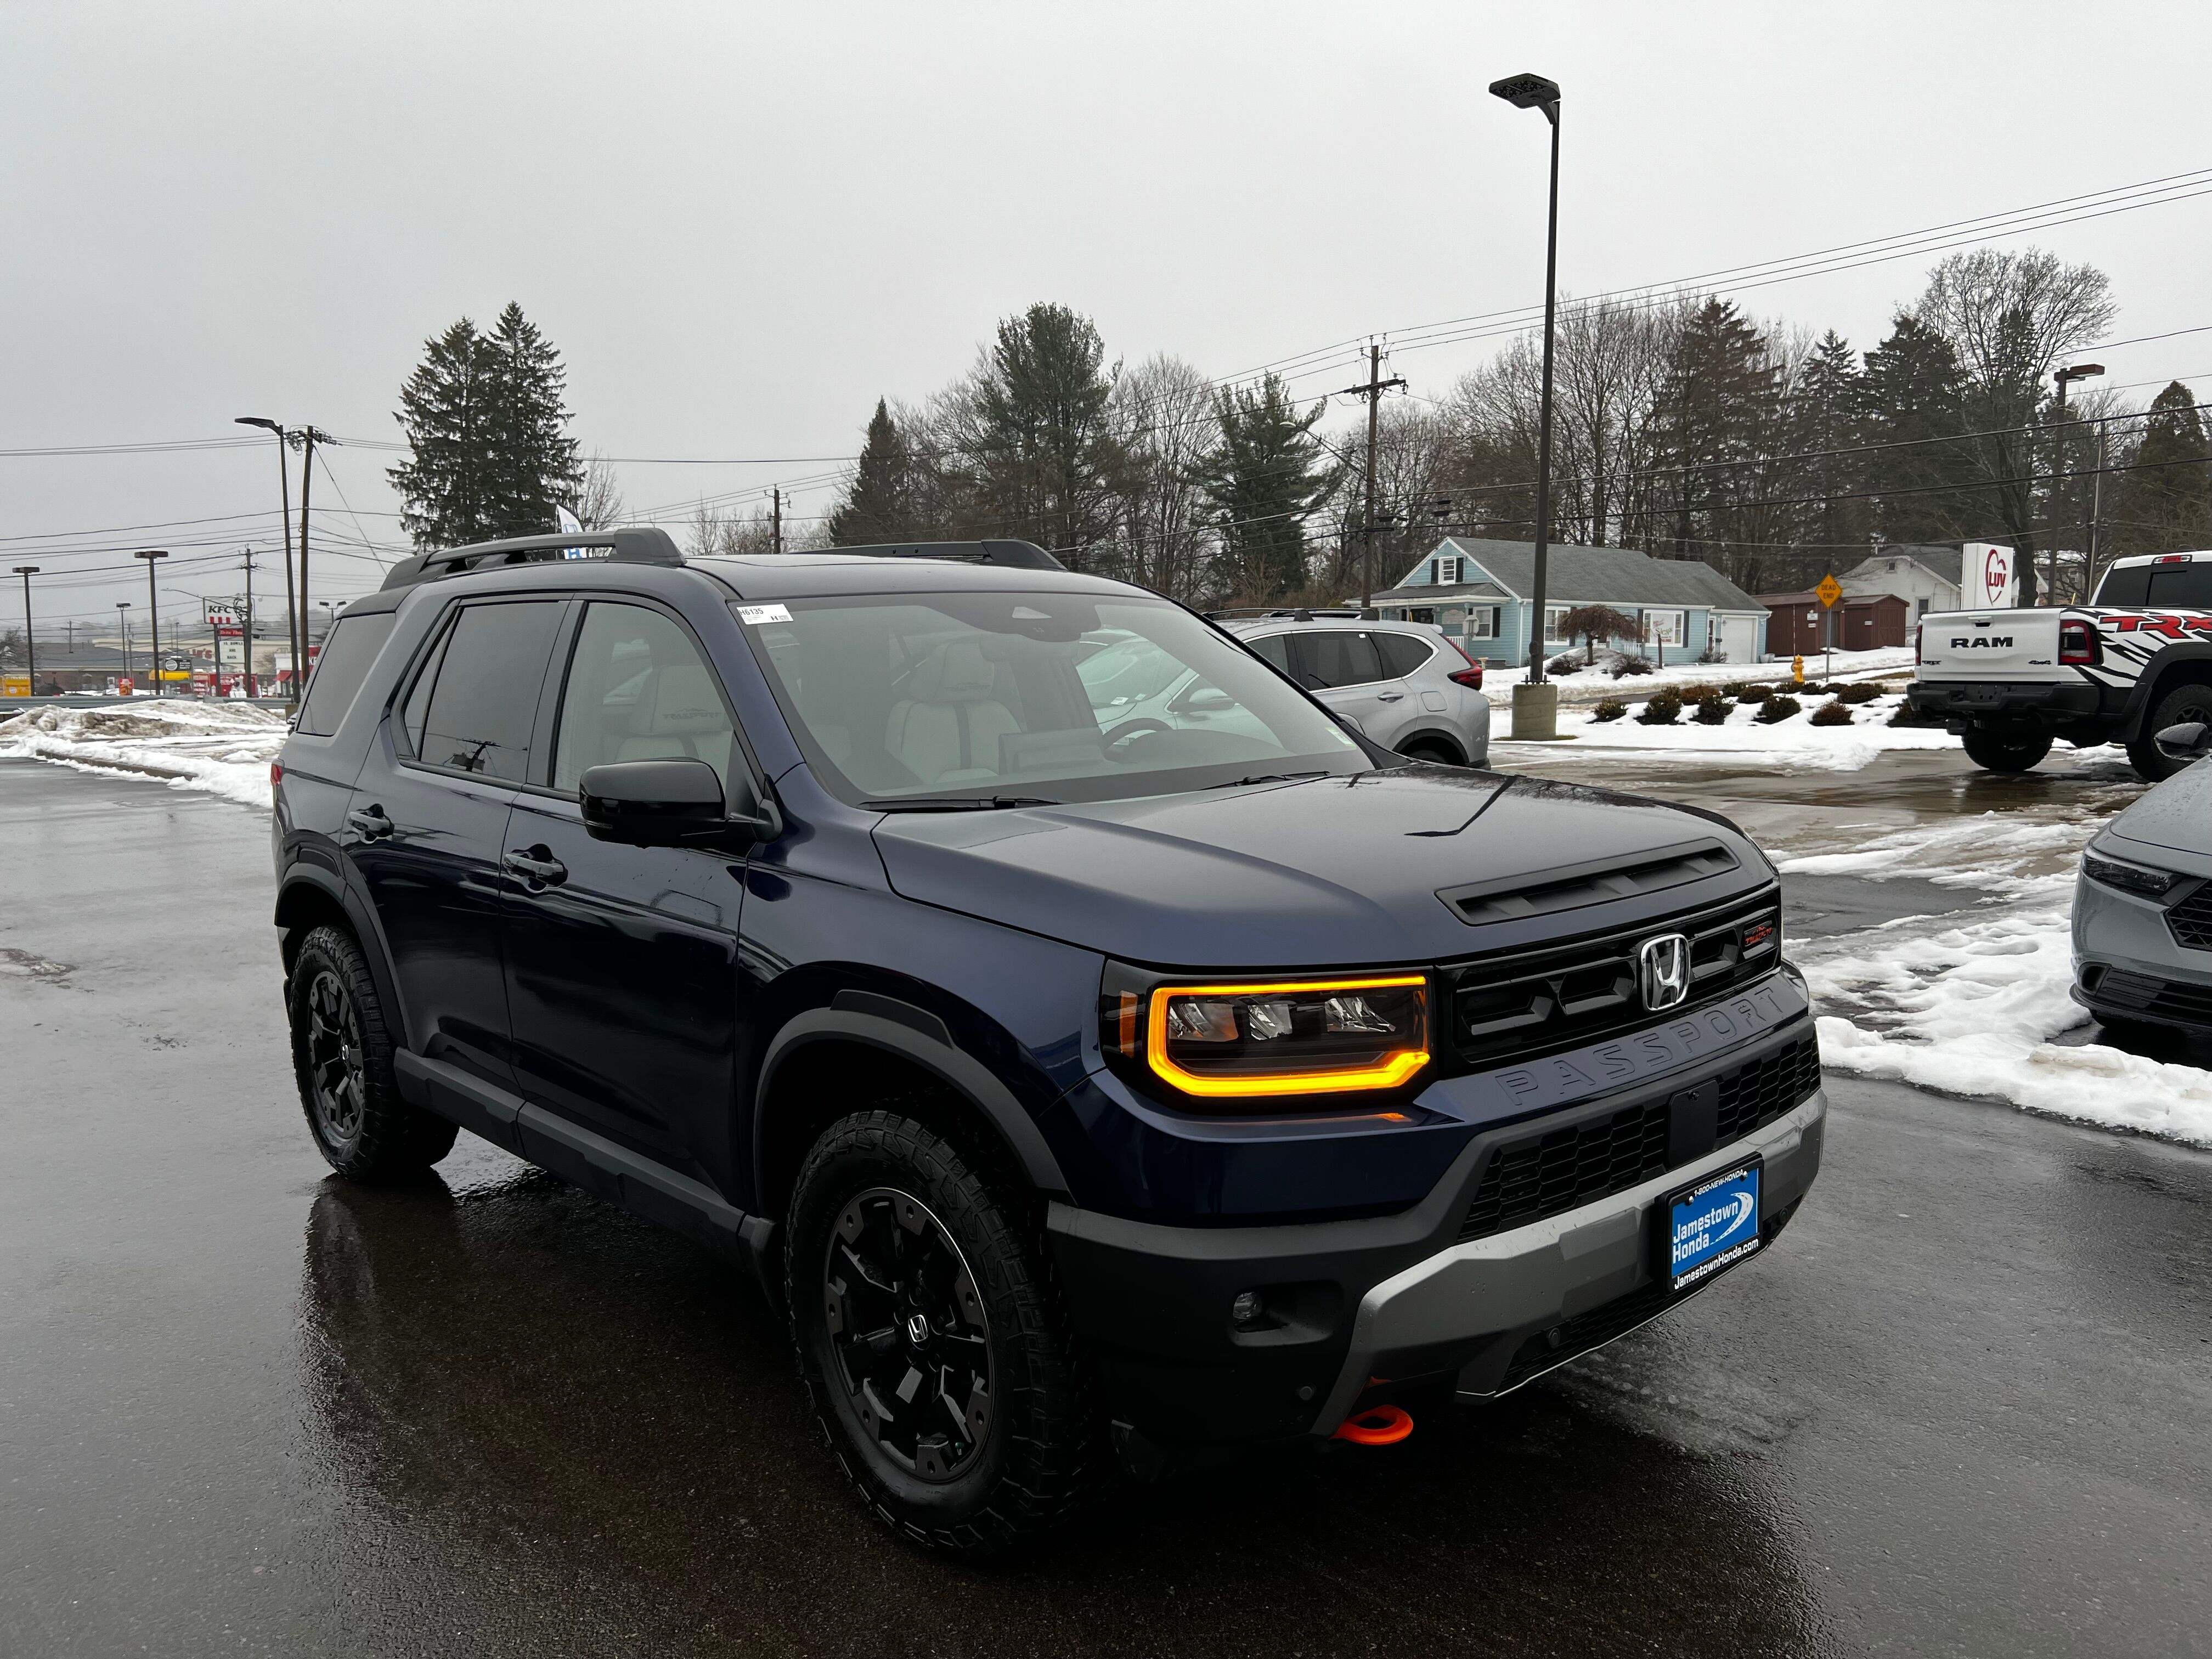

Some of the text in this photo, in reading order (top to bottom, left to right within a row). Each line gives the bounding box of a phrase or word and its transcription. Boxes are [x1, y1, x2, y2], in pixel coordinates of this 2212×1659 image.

[1988, 572, 2006, 588] LUV
[208, 606, 232, 614] KFC
[2099, 616, 2212, 639] TRX
[1951, 636, 2013, 648] RAM
[1495, 988, 1783, 1106] PASSPORT
[1694, 1169, 1743, 1197] 1-800-NEW-HONDA
[1673, 1201, 1739, 1244] Jamestown
[1673, 1232, 1710, 1264] Honda
[1674, 1238, 1759, 1290] JamestownHonda.com
